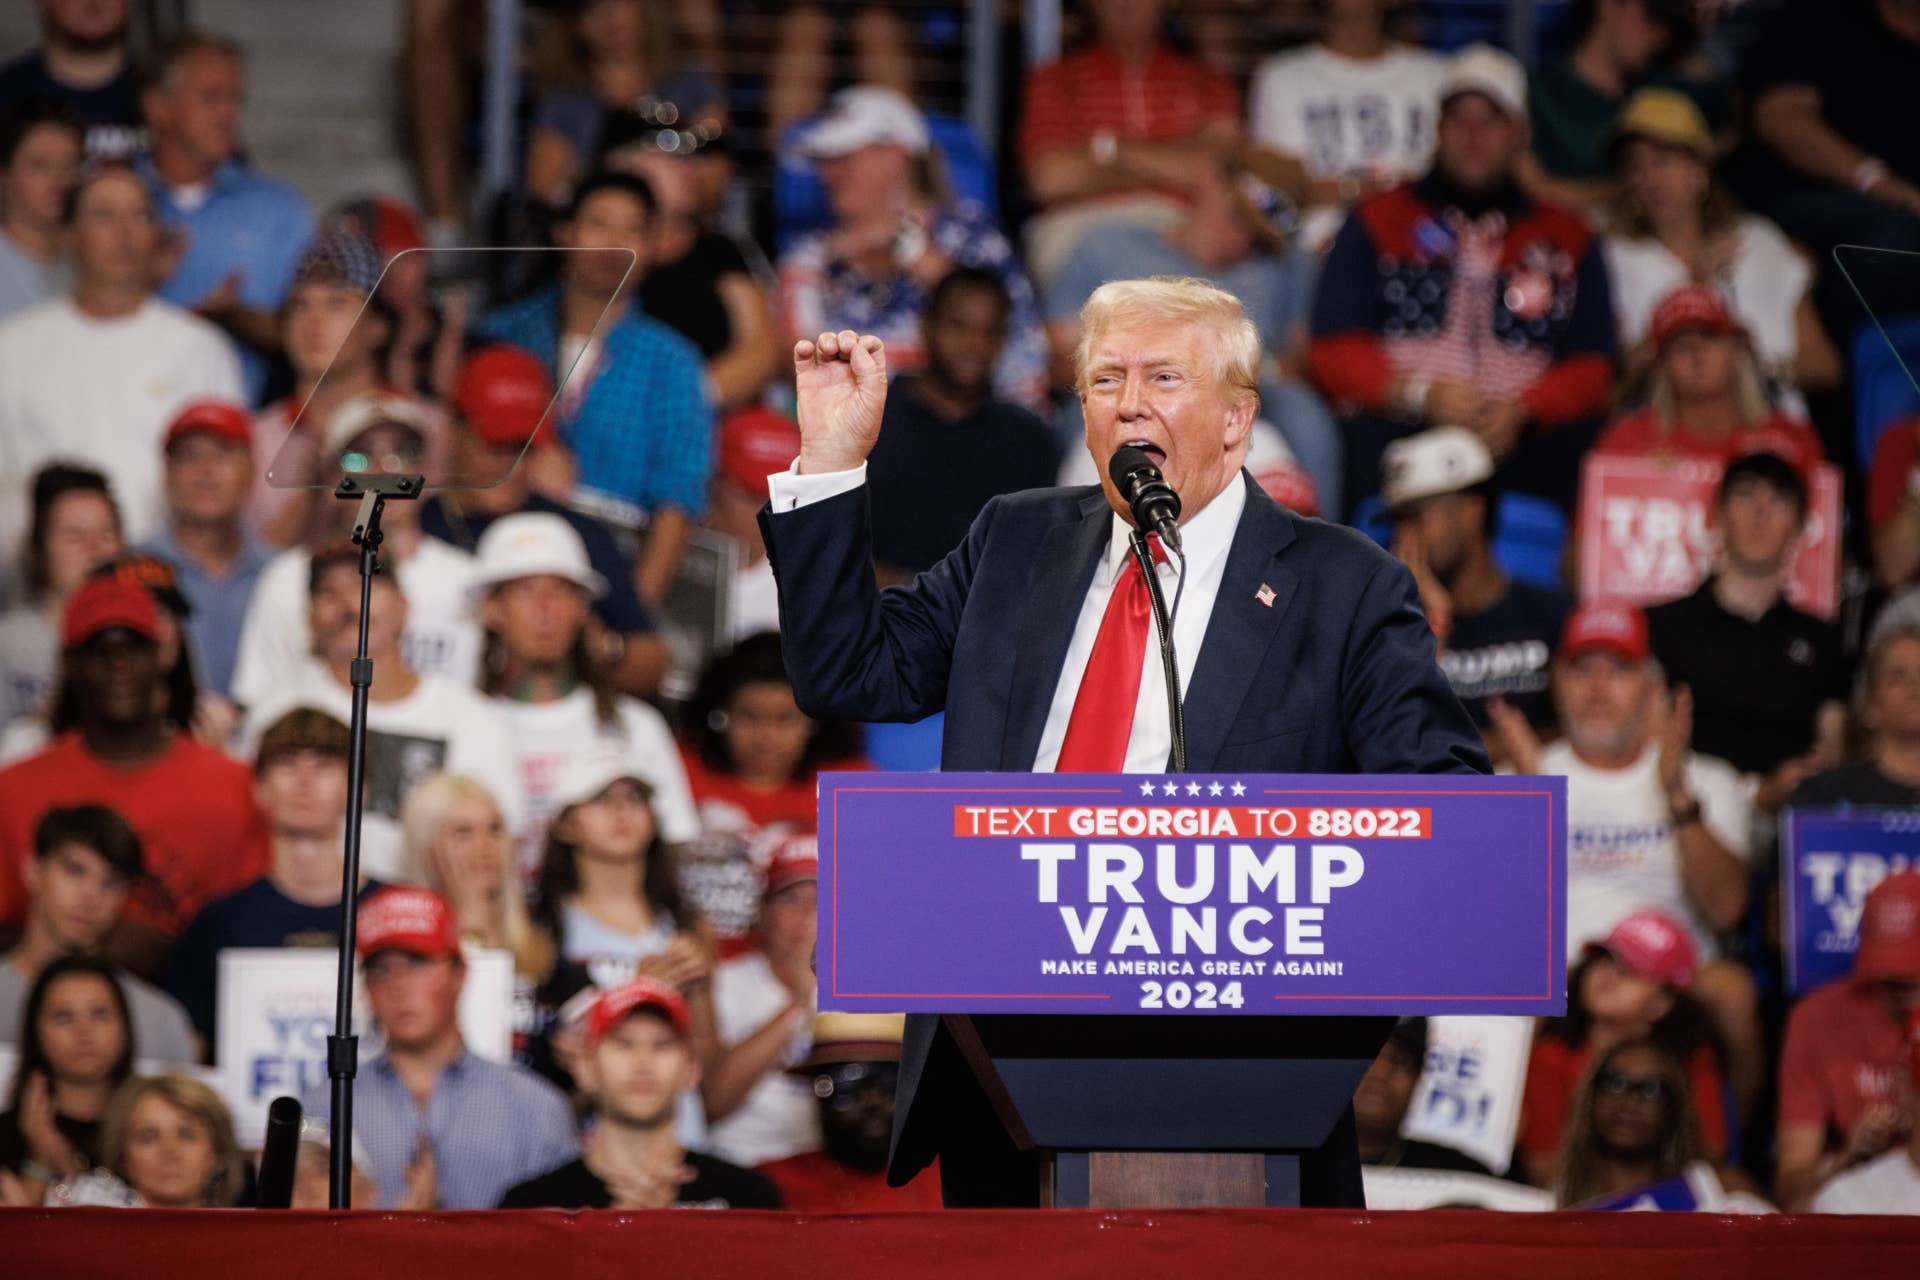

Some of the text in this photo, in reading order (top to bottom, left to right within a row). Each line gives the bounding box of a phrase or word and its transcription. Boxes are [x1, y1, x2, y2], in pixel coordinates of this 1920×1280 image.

[965, 807, 1421, 838] TEXT GEORGIA TO 88022
[1020, 843, 1365, 905] TRUMP
[1058, 905, 1325, 955] VANCE
[1041, 959, 1343, 977] MAKE AMERICA GREAT AGAIN!
[1139, 979, 1245, 1010] 2024
